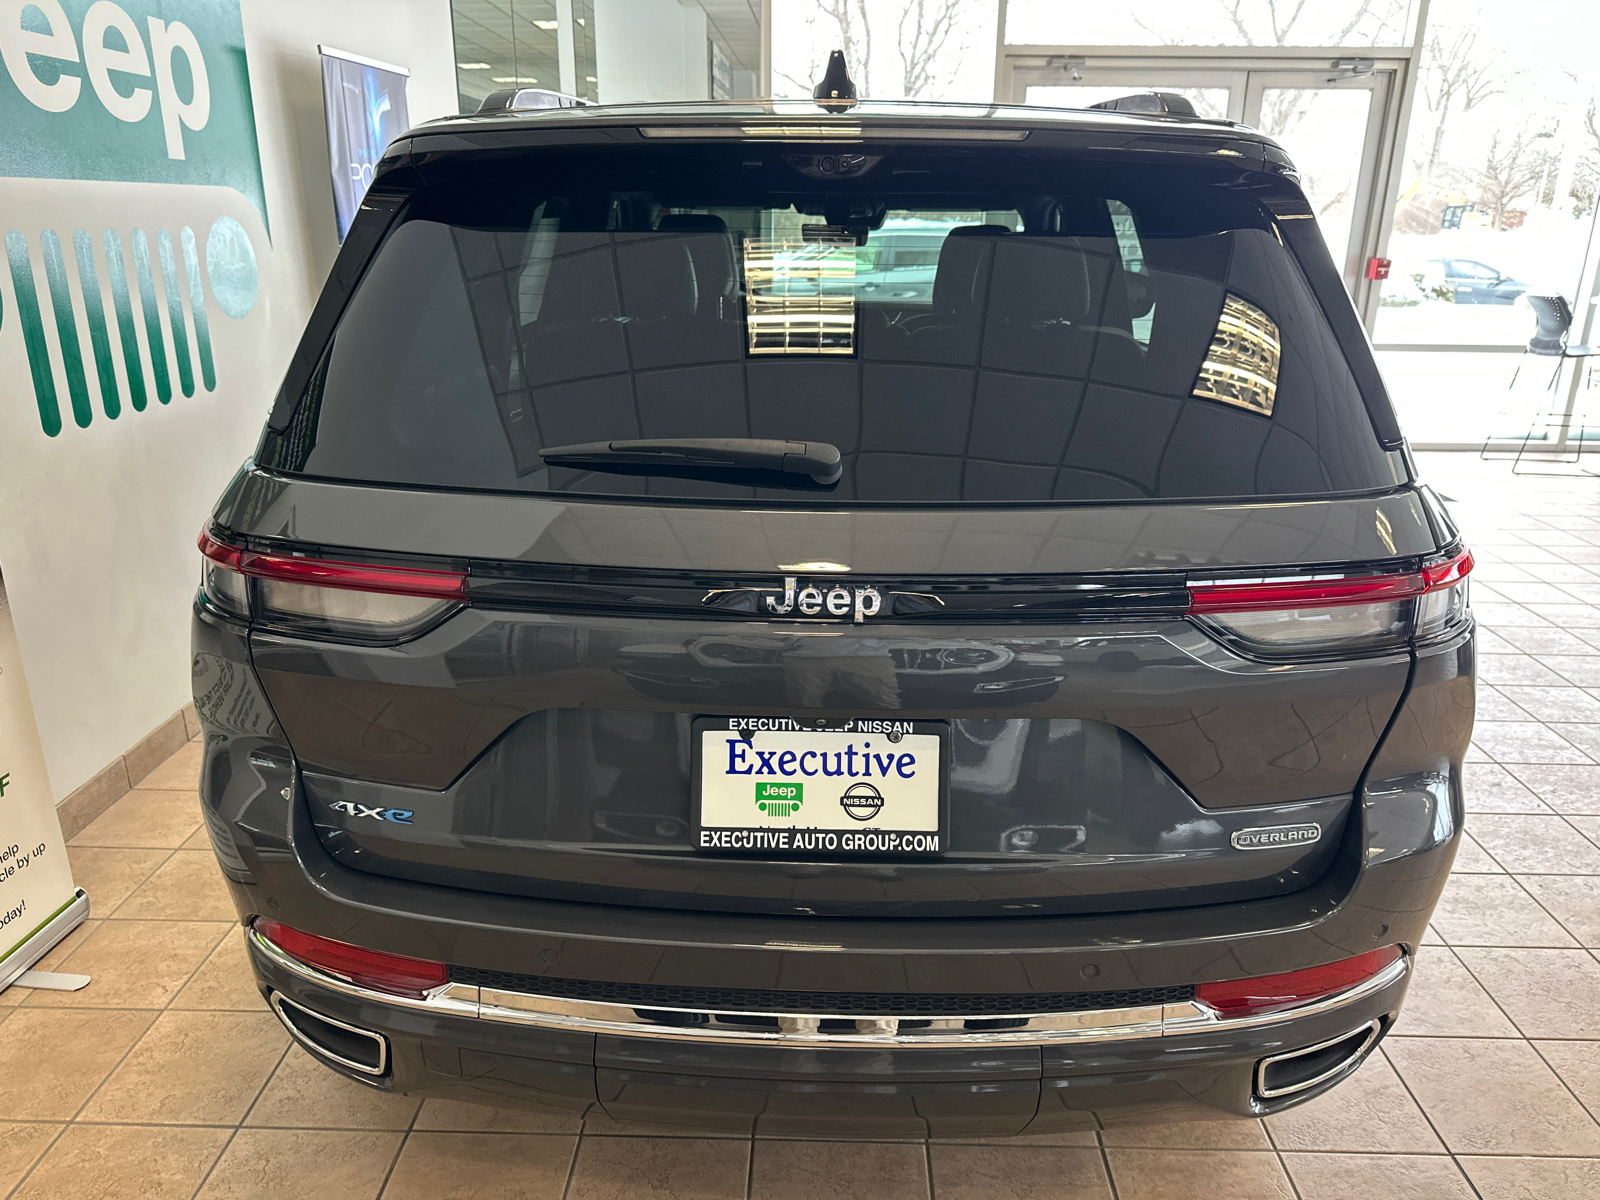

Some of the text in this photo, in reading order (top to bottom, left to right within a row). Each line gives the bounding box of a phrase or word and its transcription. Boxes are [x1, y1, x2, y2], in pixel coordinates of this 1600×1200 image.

[765, 576, 882, 623] Jeep
[728, 718, 812, 731] EXECUTIV
[857, 720, 914, 734] NISSAN
[725, 738, 916, 779] Executive
[762, 784, 797, 799] Jeep
[843, 798, 882, 806] NISSAN
[700, 830, 939, 852] EXECUTIVE AUTO GROUP.COM
[1238, 829, 1318, 845] OVERLAND
[16, 853, 30, 870] by
[32, 842, 46, 858] up
